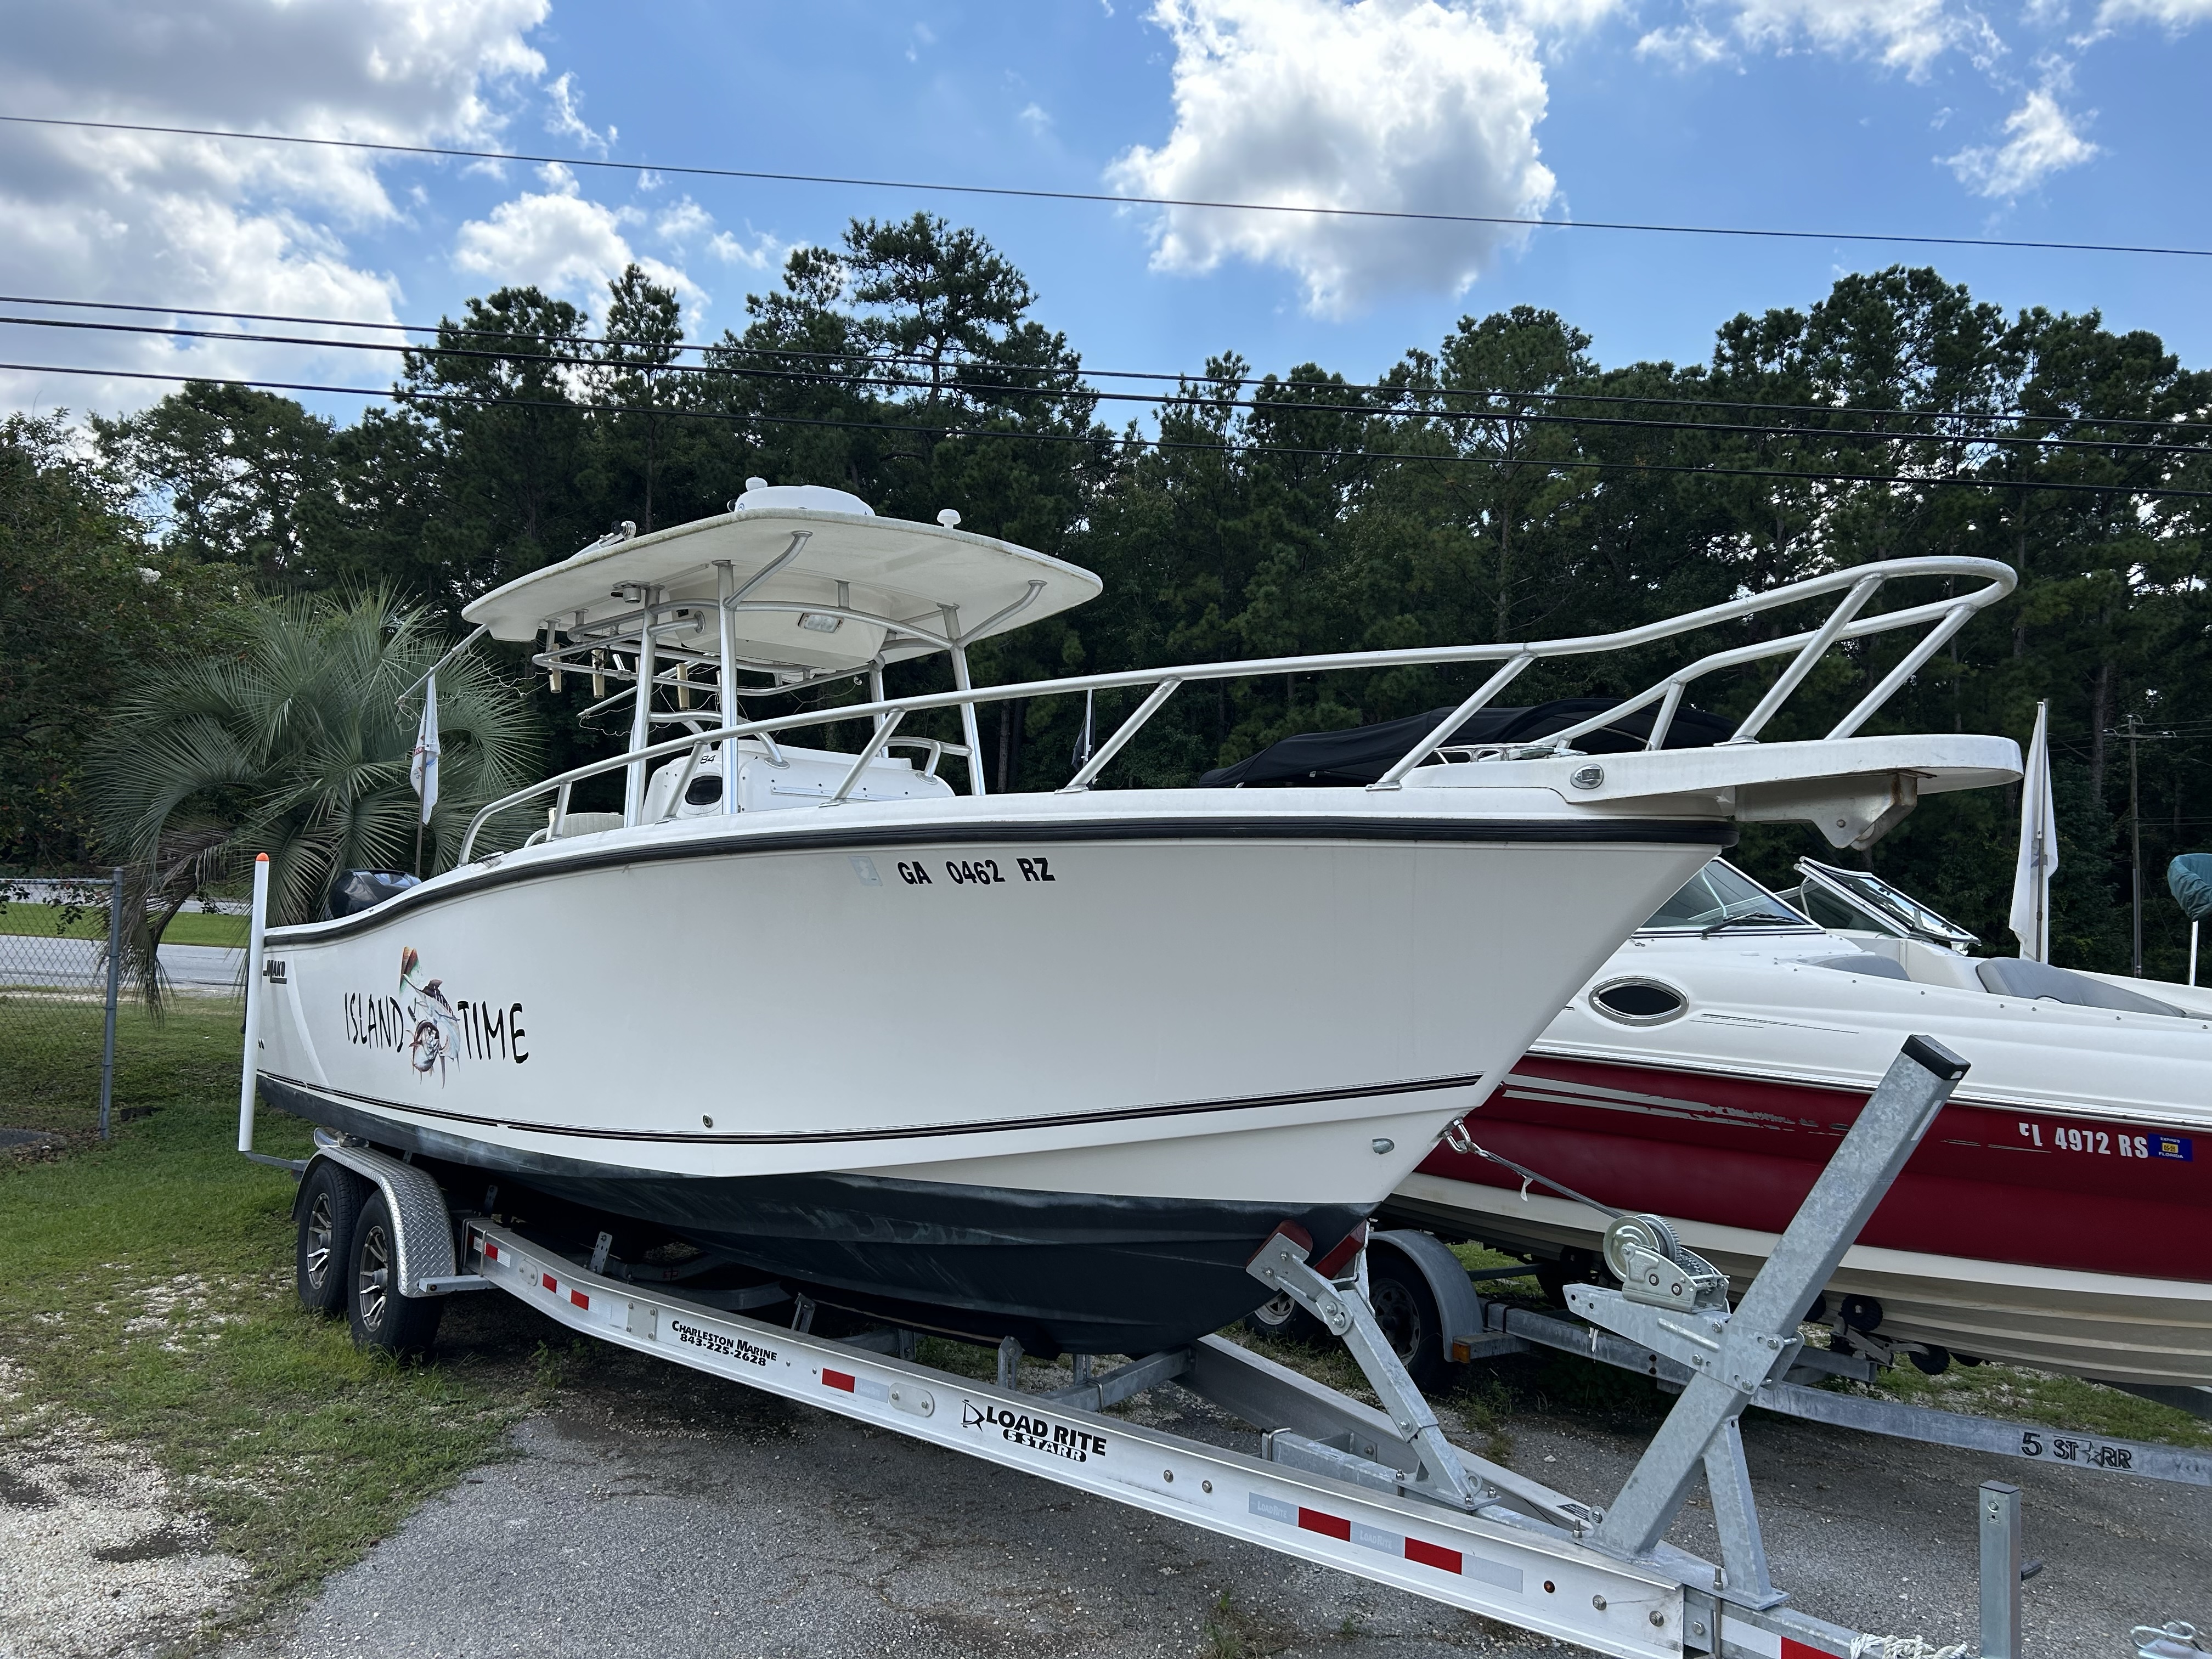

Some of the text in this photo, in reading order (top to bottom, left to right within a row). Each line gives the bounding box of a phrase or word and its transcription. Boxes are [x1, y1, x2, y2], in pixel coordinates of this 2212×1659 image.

[897, 857, 1056, 885] GA 0462 RZ
[263, 960, 286, 980] MAKO
[344, 992, 529, 1064] ISLAND TIME
[2055, 1127, 2111, 1155] 4972
[2118, 1135, 2149, 1159] RS
[680, 1333, 766, 1367] 843-225-2628
[986, 1405, 1107, 1457] LOAD RITE
[1007, 1430, 1082, 1462] 5 STARR
[2021, 1431, 2044, 1457] 5
